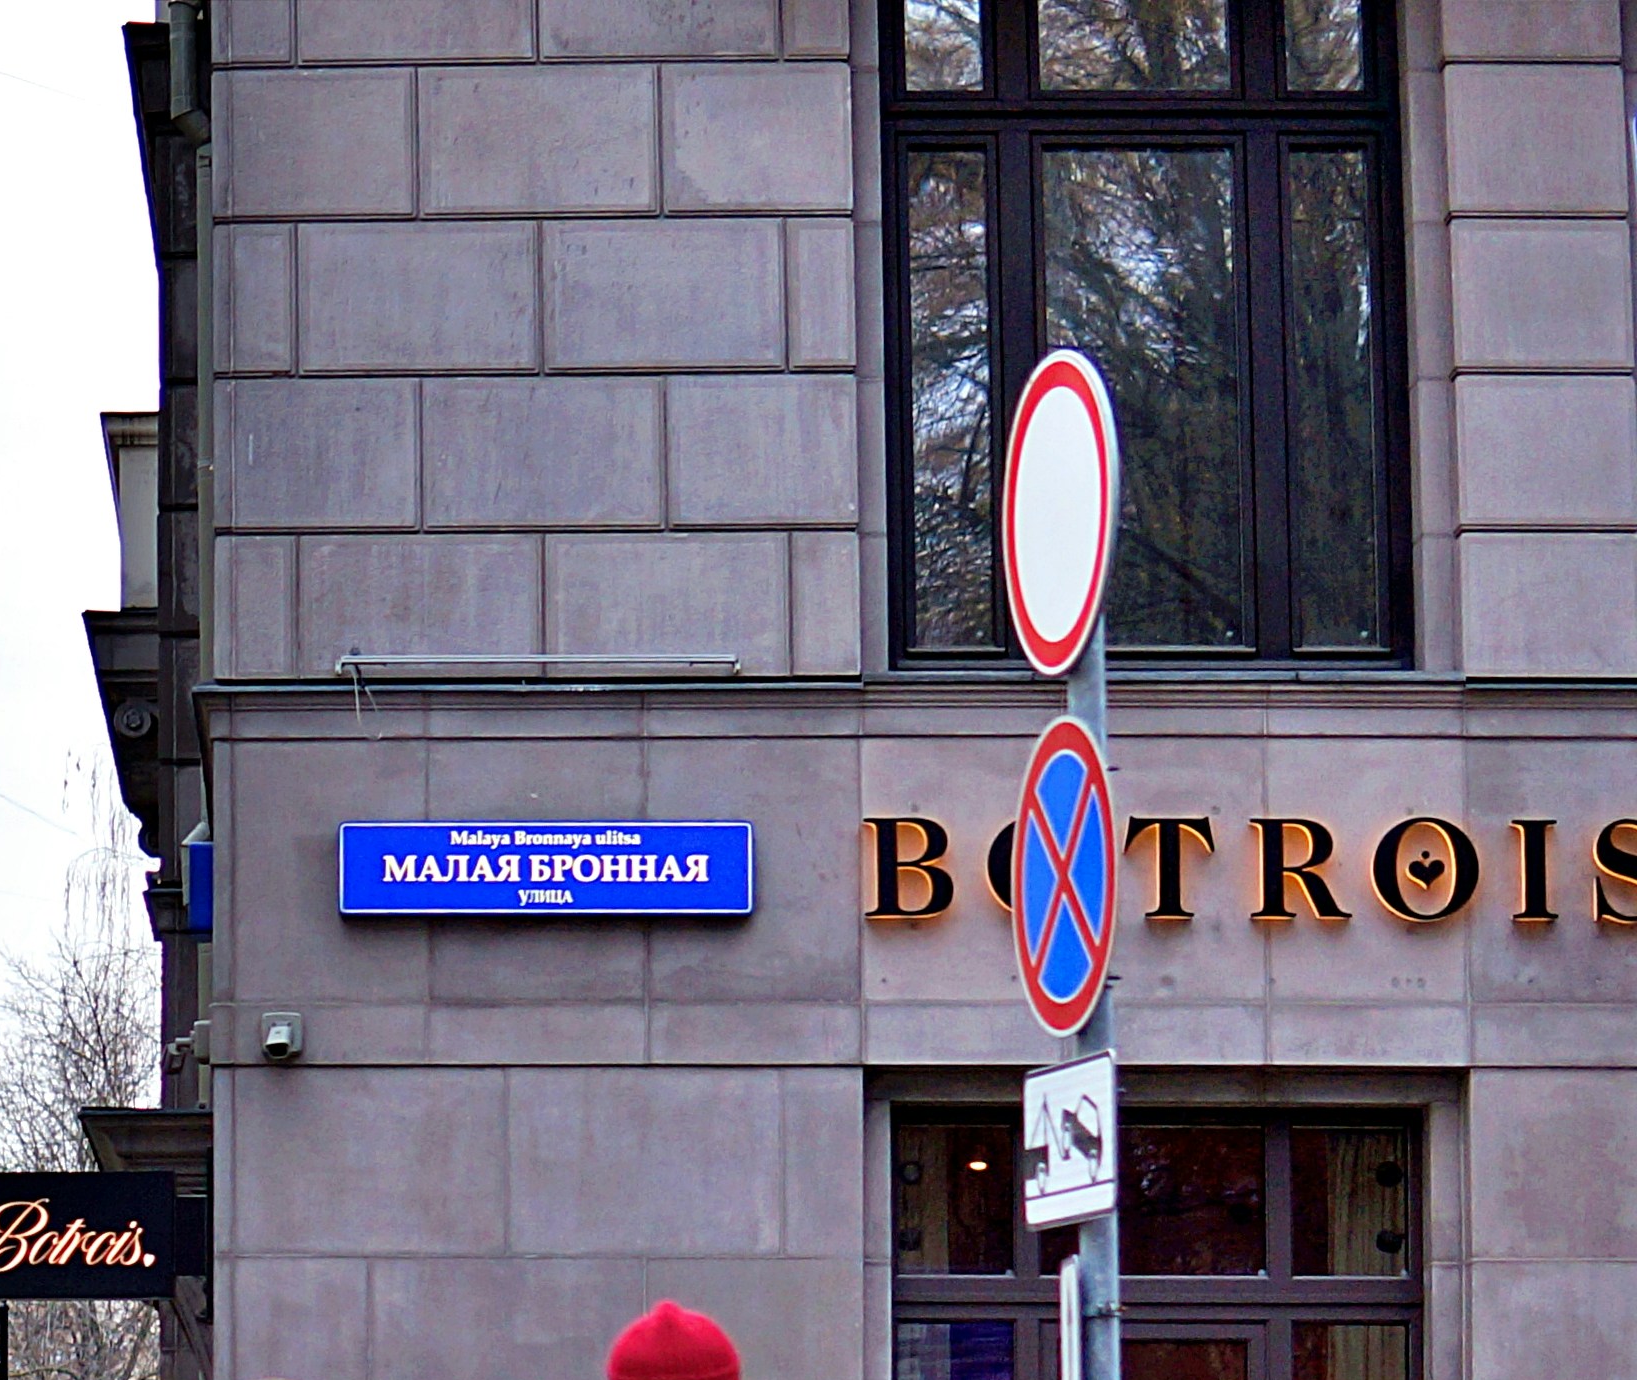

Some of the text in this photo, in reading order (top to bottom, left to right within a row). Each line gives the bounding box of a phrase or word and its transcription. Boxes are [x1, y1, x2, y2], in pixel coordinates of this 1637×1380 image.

[450, 830, 641, 849] Malaya Bronnaya ulitsa
[382, 854, 710, 882] МАЛАЯ БРОННАЯ
